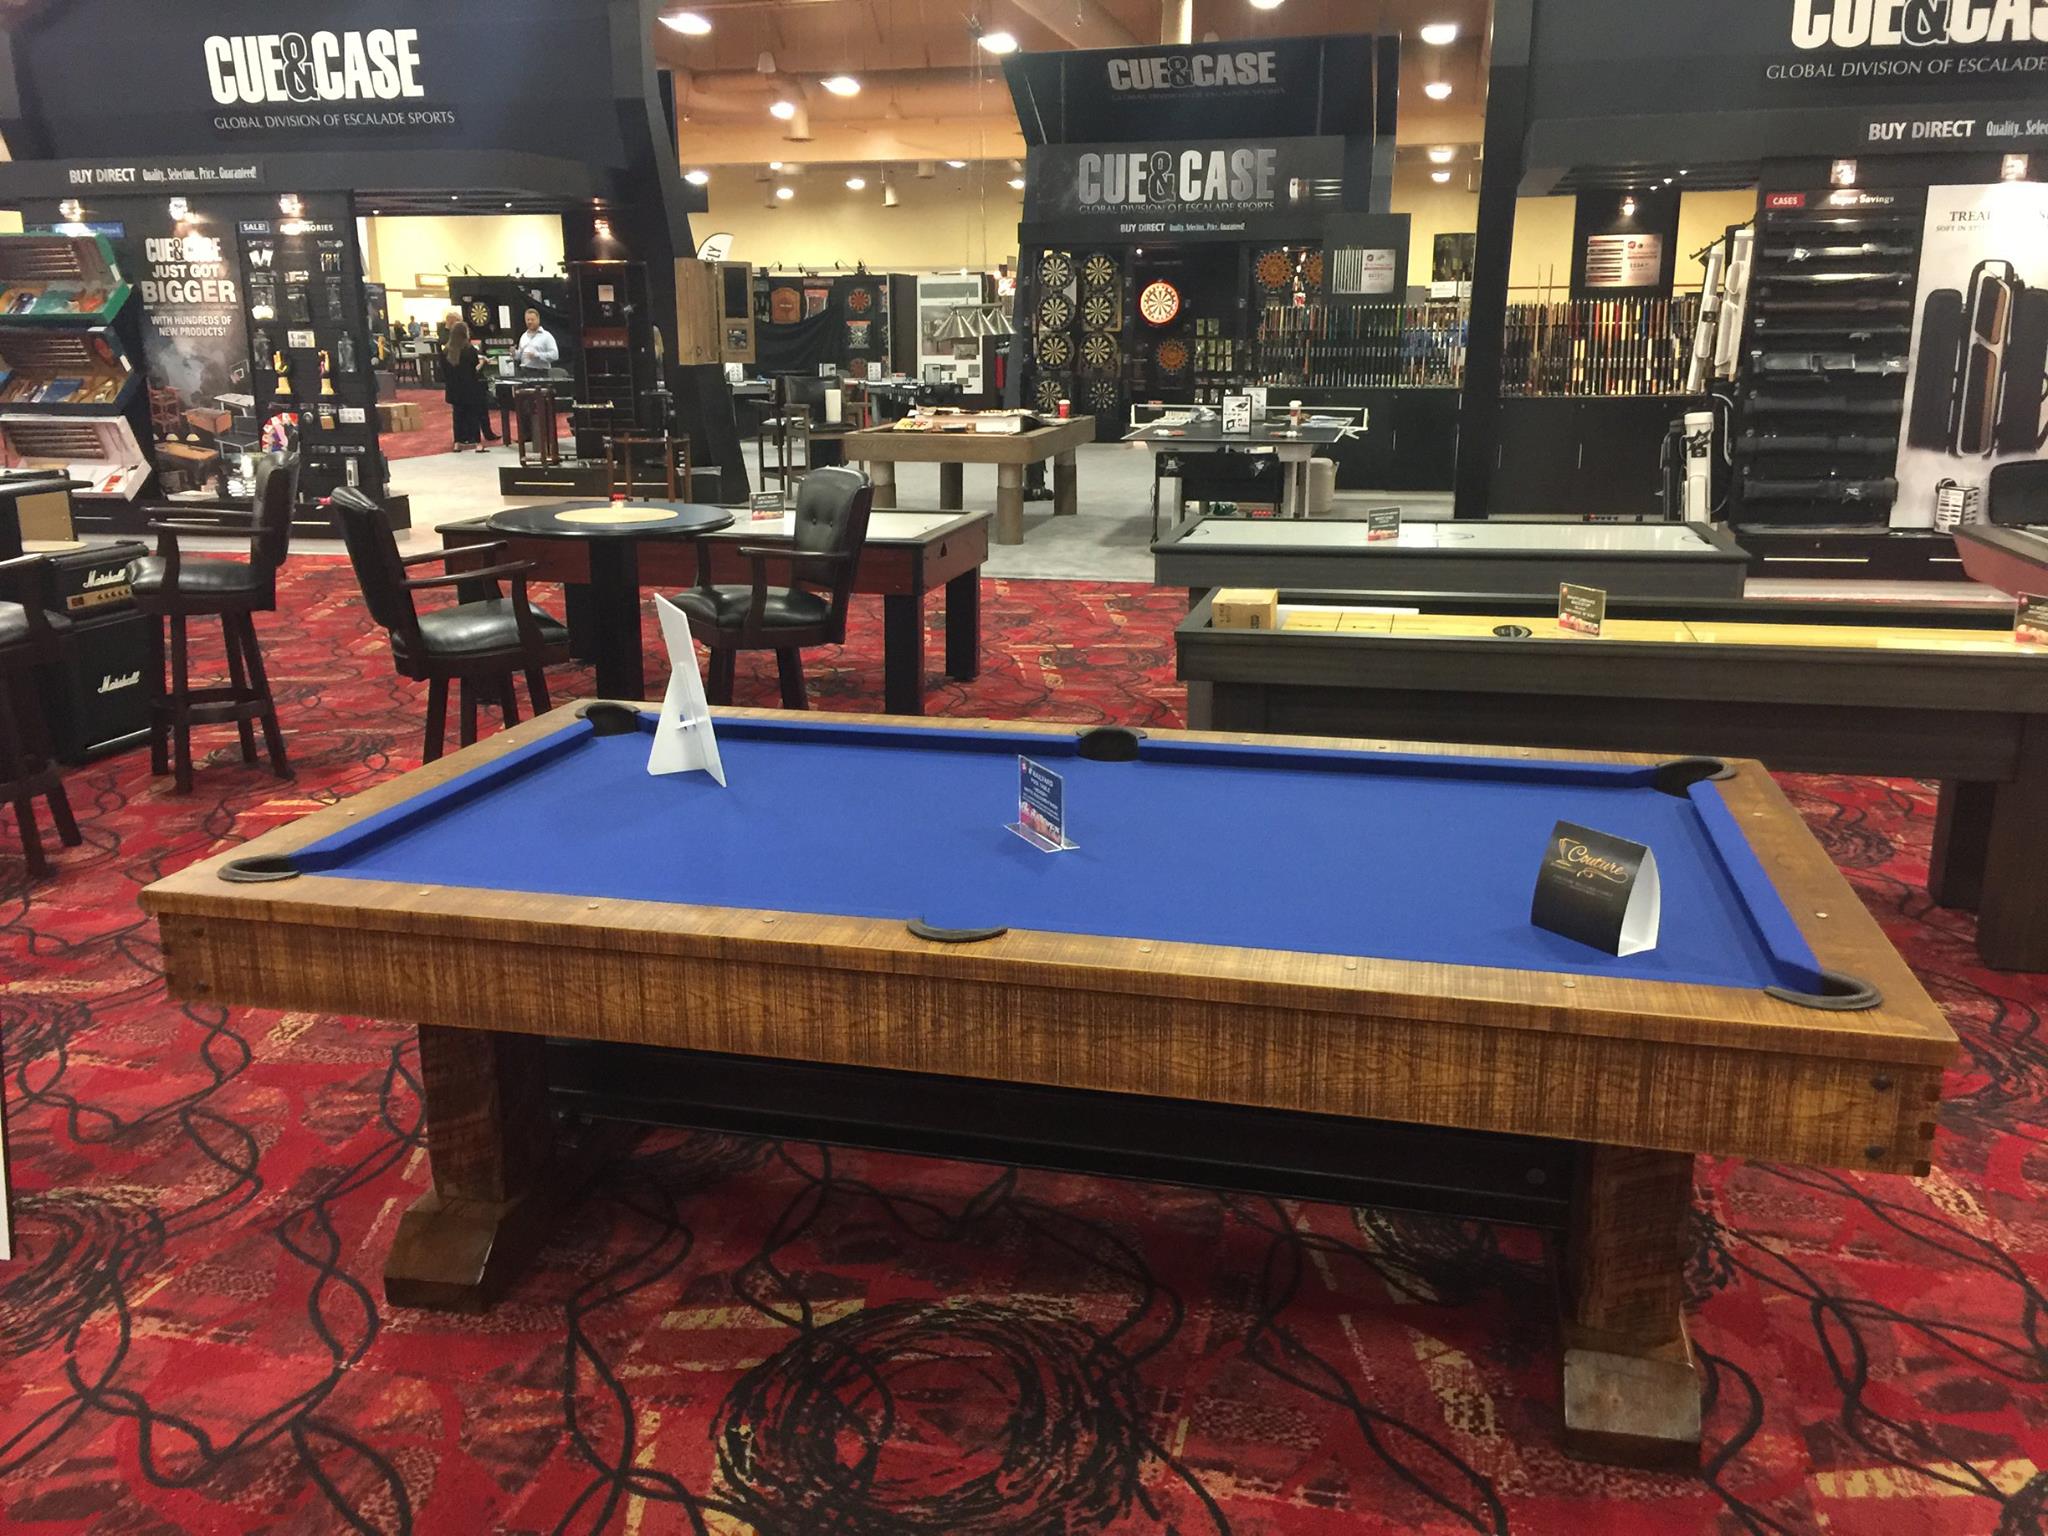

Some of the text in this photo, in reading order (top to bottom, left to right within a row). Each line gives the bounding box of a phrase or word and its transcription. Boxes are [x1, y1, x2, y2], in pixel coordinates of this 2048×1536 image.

[203, 28, 424, 104] CUE&CASE
[1107, 51, 1276, 91] CUE&CASE
[1766, 56, 2048, 79] GLOBAL DIVISION OF ESCALADE
[213, 111, 455, 129] GLOBAL DIVISION OF ESCALADE SPORTS
[1868, 123, 1907, 141] BUY
[1911, 119, 1976, 138] DIRECT
[69, 169, 92, 183] BUY
[96, 168, 136, 182] DIRECT
[1078, 149, 1277, 204] CUE&CASE
[1079, 201, 1275, 214] GLOBAL DIVISION OF ESCALADE SPORTS
[1773, 196, 1798, 206] CASES
[1859, 193, 1895, 204] Savings
[243, 223, 266, 231] SALE!
[1120, 223, 1136, 232] BUY
[1138, 223, 1165, 232] DIRECT
[152, 263, 220, 278] JUST GOT
[141, 280, 236, 303] BIGGER
[151, 315, 232, 325] WITH HUNDREDS OF
[159, 327, 226, 337] NEW PRODUCTS!
[83, 568, 126, 588] Marshall
[97, 671, 140, 693] Marshall
[1568, 845, 1628, 879] Couture
